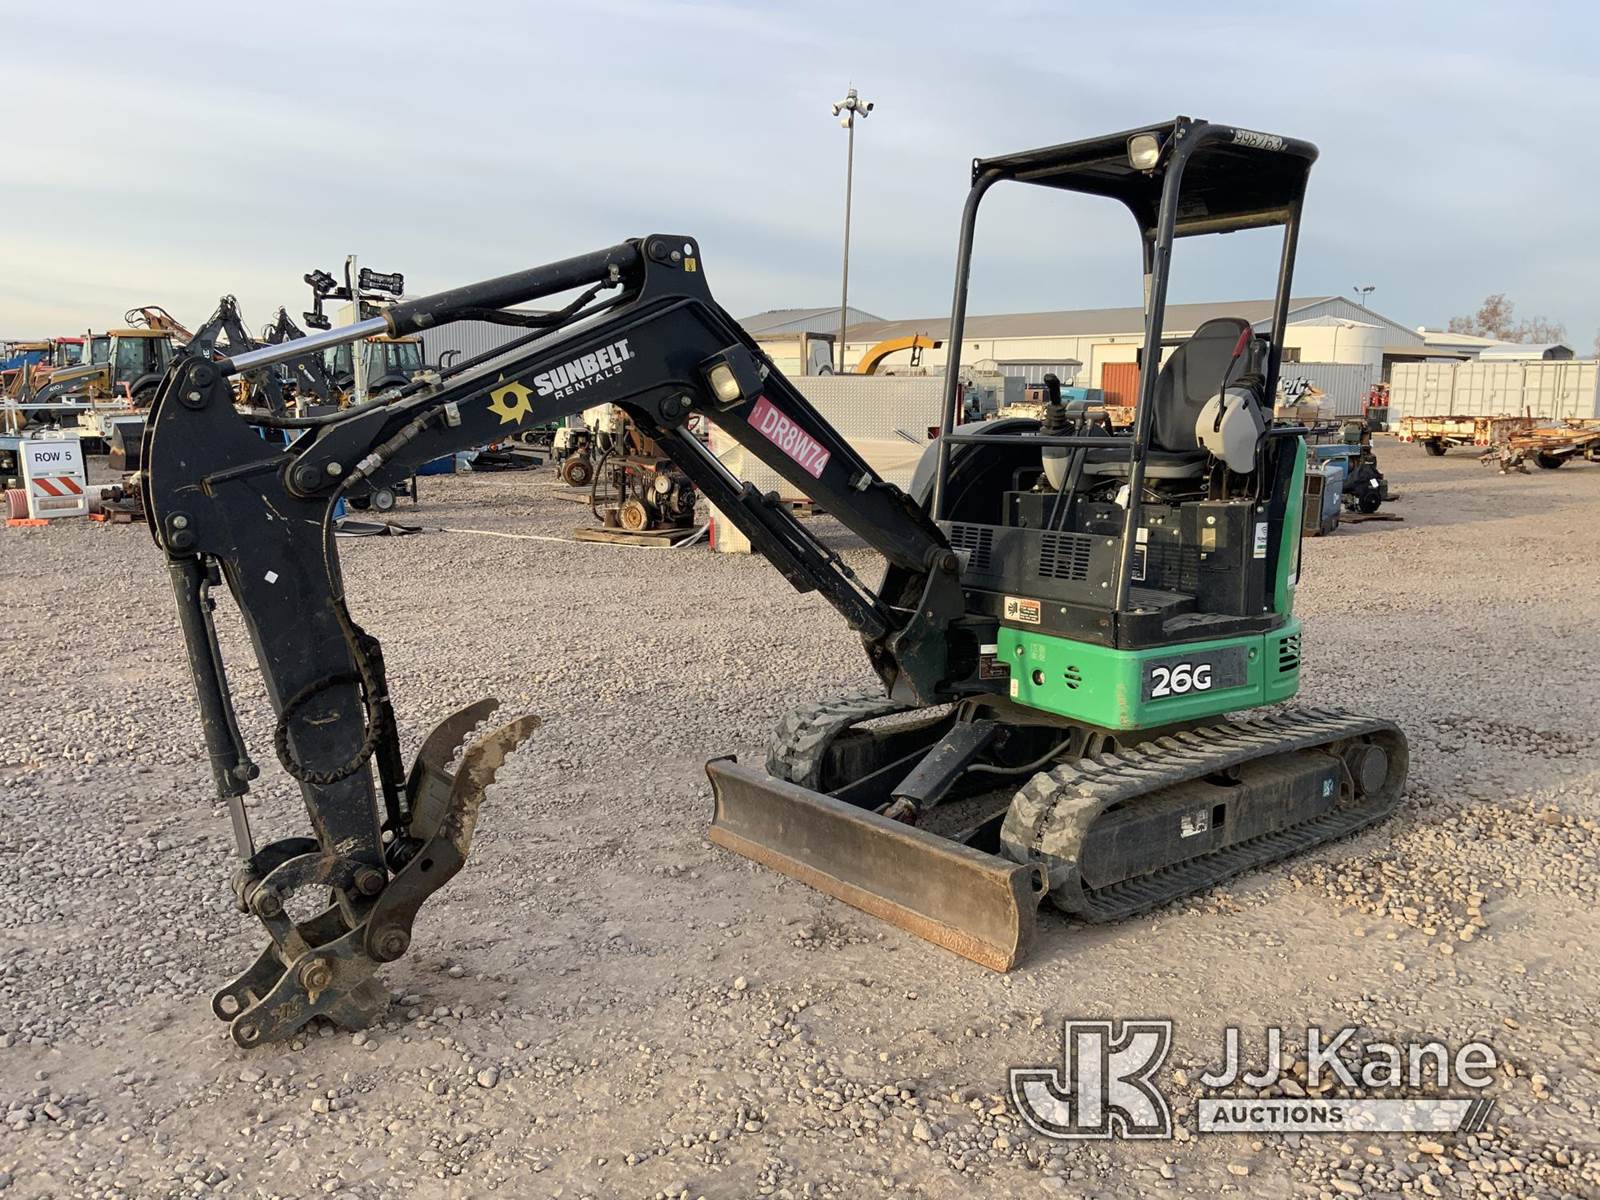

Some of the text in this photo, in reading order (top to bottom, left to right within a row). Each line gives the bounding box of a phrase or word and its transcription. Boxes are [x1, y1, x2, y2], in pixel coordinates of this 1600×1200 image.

[533, 338, 629, 396] SUNBELT
[554, 364, 623, 400] RENTALS
[34, 451, 72, 462] ROW 5
[760, 407, 829, 476] DR8W74
[1151, 663, 1212, 698] 26G
